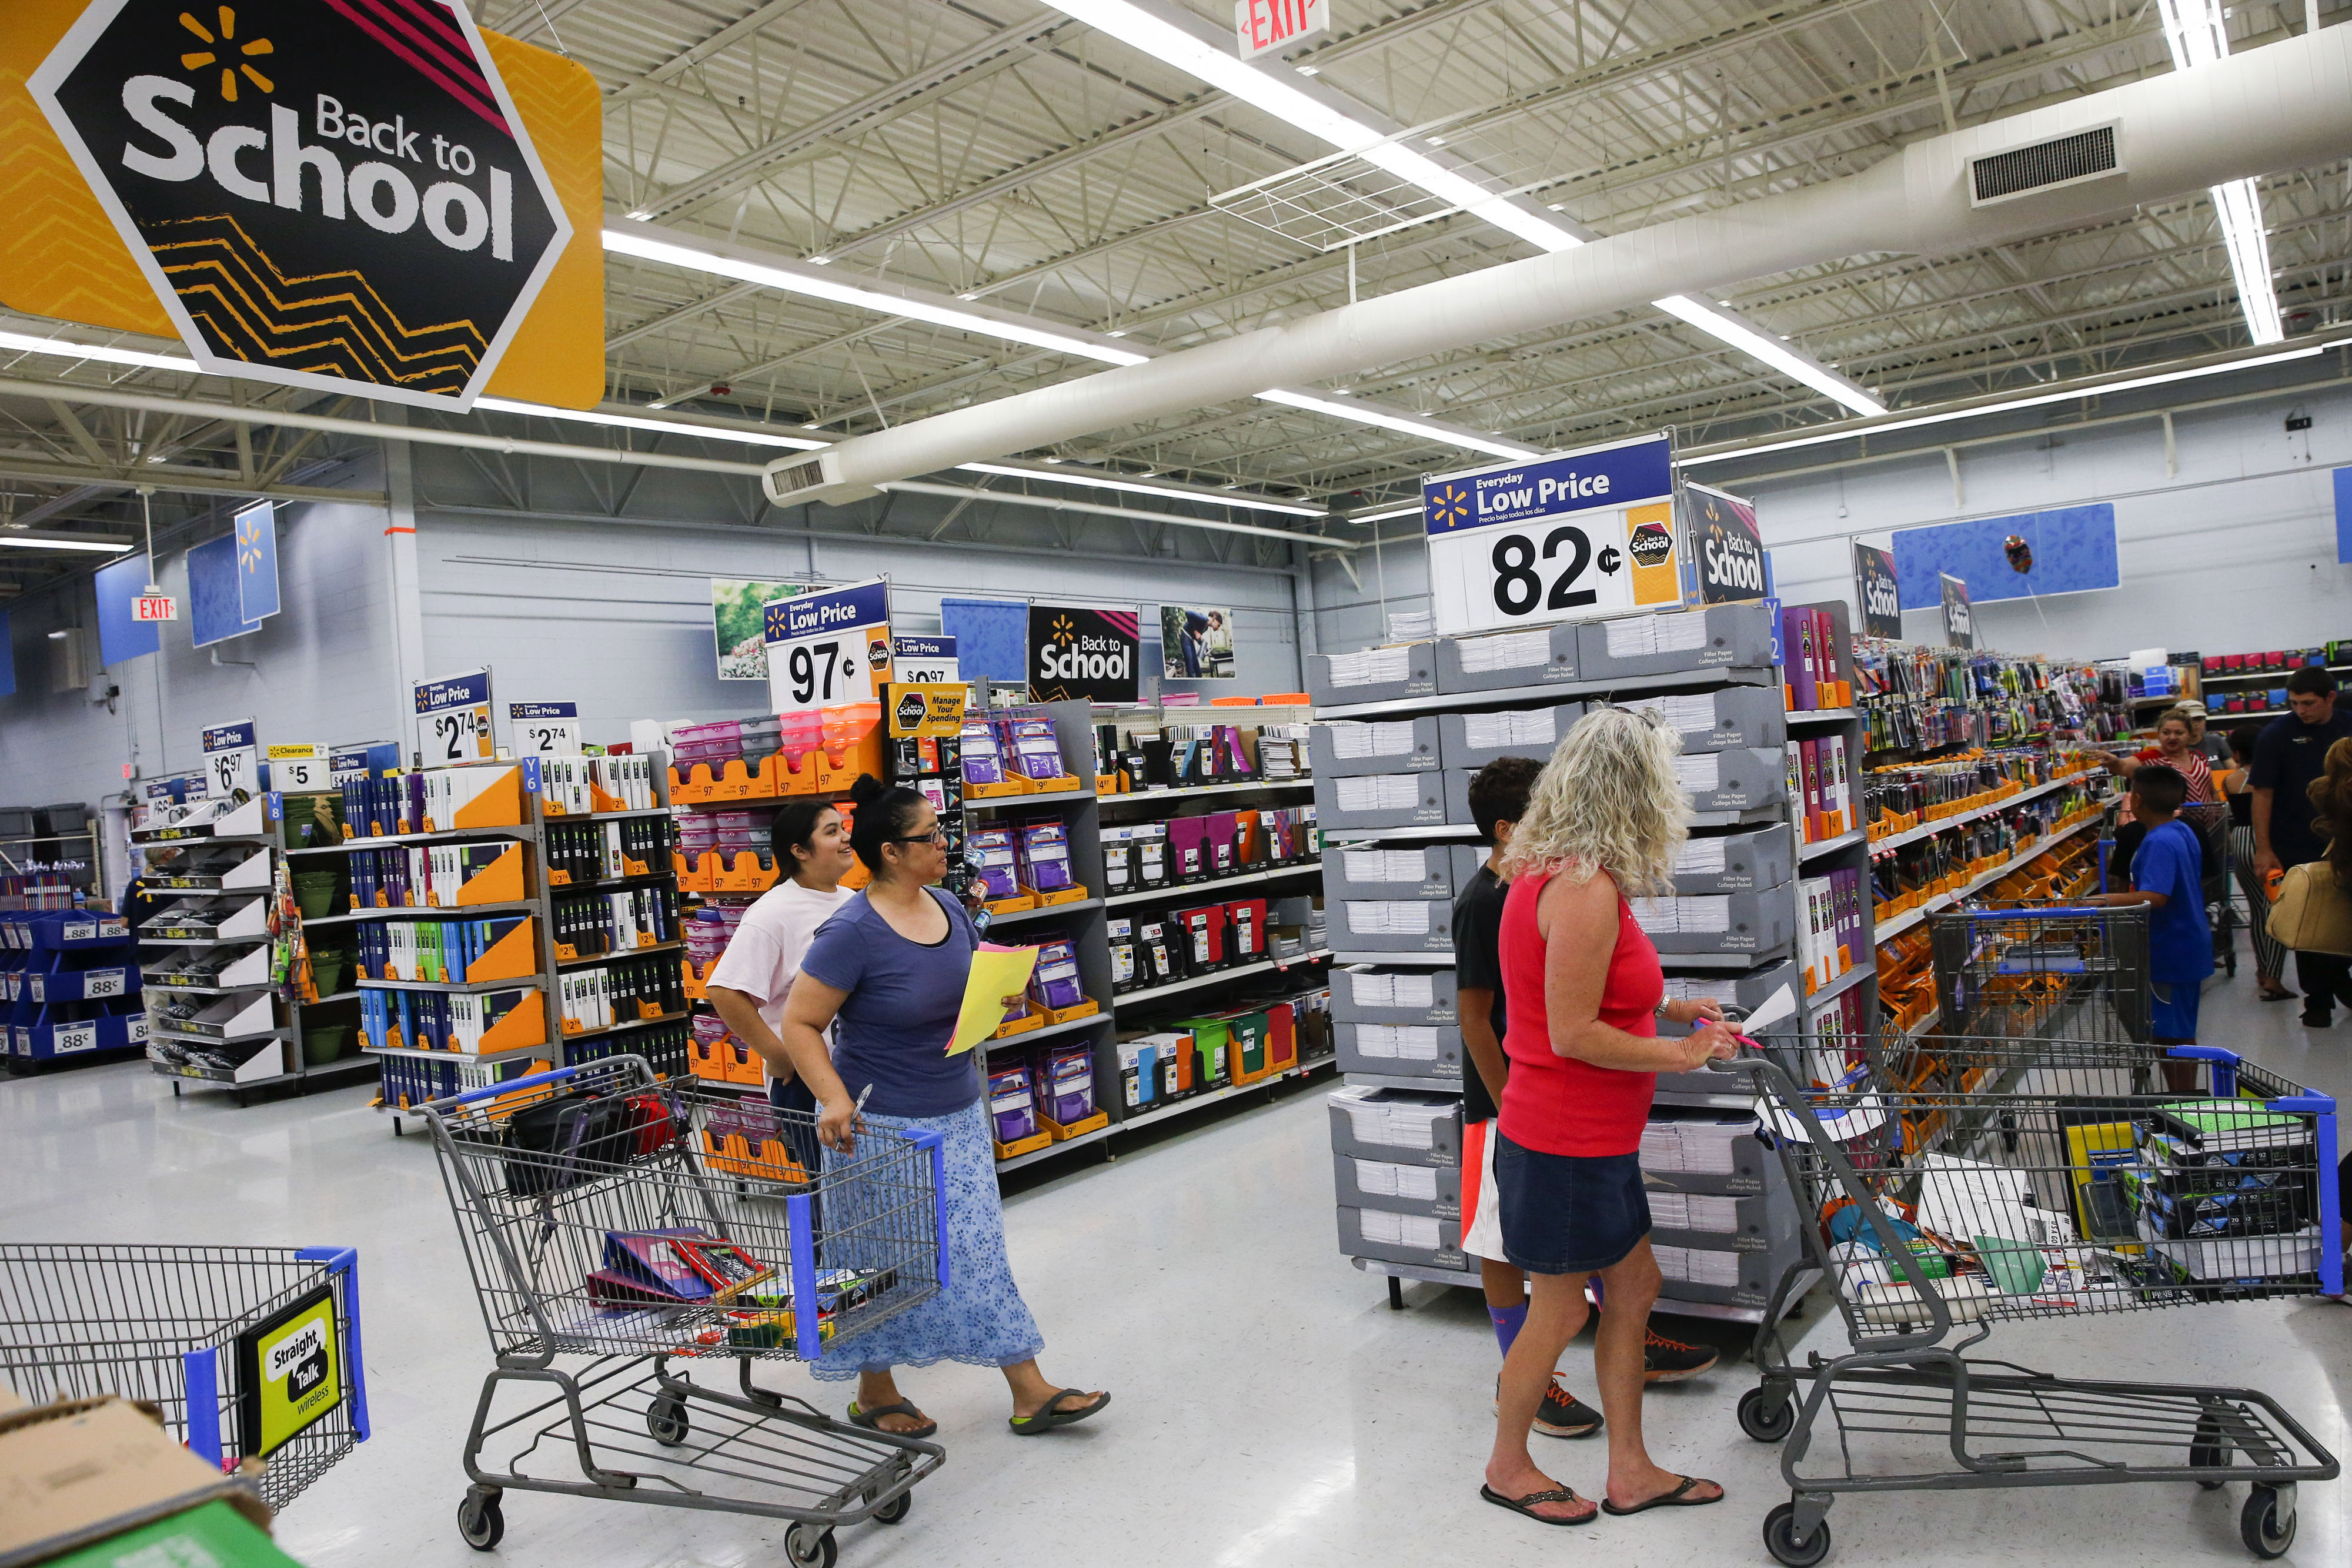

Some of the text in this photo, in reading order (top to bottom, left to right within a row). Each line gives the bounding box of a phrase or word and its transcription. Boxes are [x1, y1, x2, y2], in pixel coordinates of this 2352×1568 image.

[1249, 0, 1307, 51] EXIT
[316, 93, 475, 176] Back to
[122, 75, 514, 262] School
[1476, 473, 1524, 492] Everyday
[1476, 473, 1610, 514] Low Price
[1509, 510, 1524, 519] todos
[1632, 536, 1669, 553] School
[1727, 531, 1753, 555] Back to
[1706, 539, 1763, 591] School
[790, 601, 814, 612] Everyday
[1866, 580, 1899, 617] School
[140, 599, 170, 619] EXIT
[790, 602, 857, 630] Low Price
[1765, 601, 1778, 627] Y
[902, 643, 940, 653] Low Price
[1081, 635, 1121, 651] Back to
[1771, 637, 1780, 659] 2
[869, 650, 888, 661] School
[1040, 643, 1130, 680] School
[429, 684, 445, 692] Everyday
[430, 686, 470, 706] Low Price
[932, 697, 960, 706] Manage
[898, 707, 924, 716] School
[927, 714, 961, 724] Spending
[213, 731, 242, 746] Low Price
[289, 765, 309, 784] $5
[525, 758, 536, 773] Y
[527, 777, 536, 790] 6
[269, 793, 279, 804] Y
[272, 808, 280, 819] 8
[274, 1329, 318, 1369] Straight
[297, 1364, 319, 1389] Talk
[298, 1385, 329, 1415] wireless
